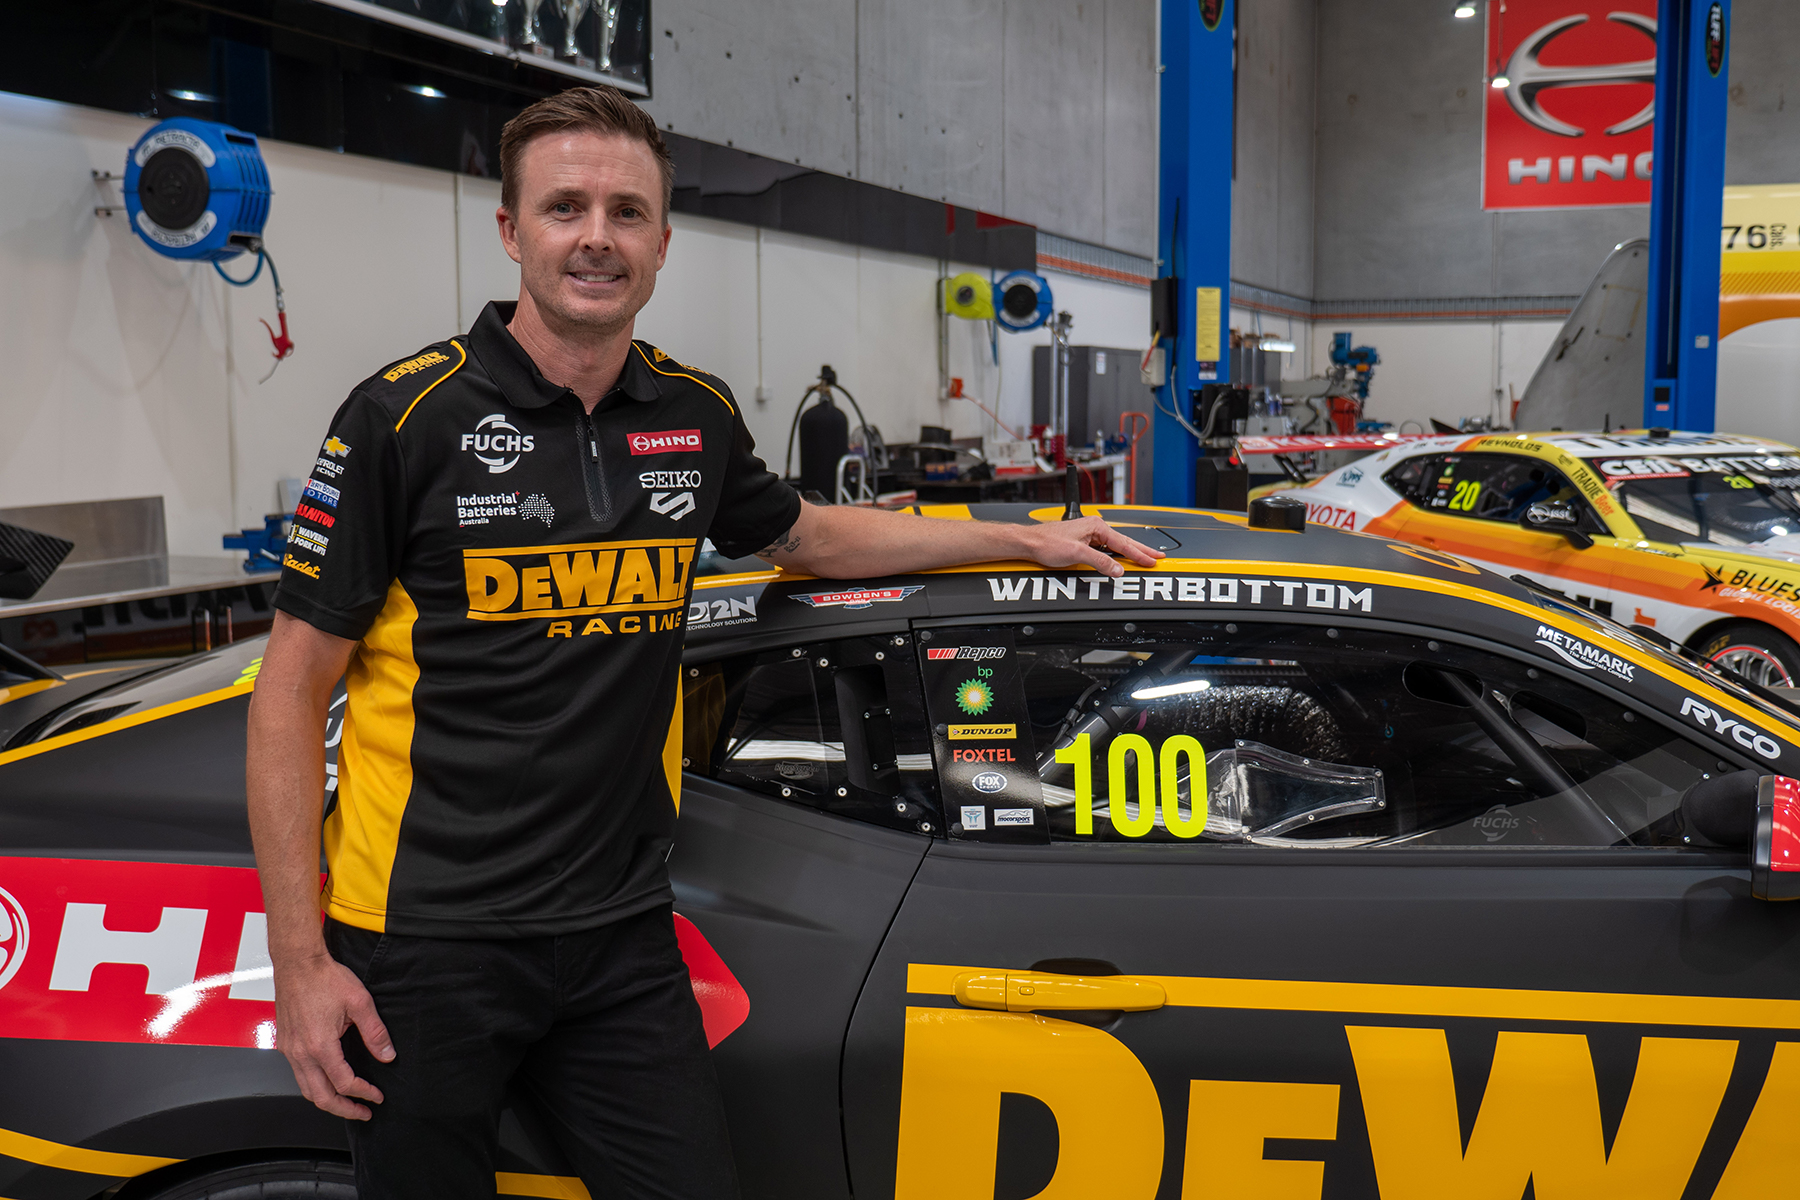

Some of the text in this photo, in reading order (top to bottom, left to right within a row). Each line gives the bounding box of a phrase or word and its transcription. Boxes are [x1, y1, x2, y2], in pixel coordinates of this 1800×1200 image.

[1721, 224, 1767, 250] 76
[461, 434, 535, 452] FUCHS
[650, 435, 699, 448] HINO
[1478, 439, 1543, 452] REYNOLDS
[639, 470, 702, 489] SEIKO
[457, 493, 518, 506] Industrial
[1448, 480, 1482, 512] 20
[1571, 467, 1615, 516] TRADIE Beer
[458, 505, 517, 518] Batteries
[1305, 502, 1357, 531] YOTA
[459, 518, 490, 527] Australia
[463, 546, 695, 612] DEWALT
[822, 591, 892, 602] BOWDEN'S
[986, 576, 1373, 612] WINTERBOTTOM
[724, 617, 757, 626] SOLUTIONS
[1536, 625, 1636, 679] METAMARK
[977, 666, 993, 679] bp
[1680, 697, 1782, 760] RYCO
[953, 749, 1016, 763] FOXTEL
[979, 776, 1000, 786] FOX
[1055, 733, 1208, 839] 100
[1473, 817, 1519, 829] FUCHS
